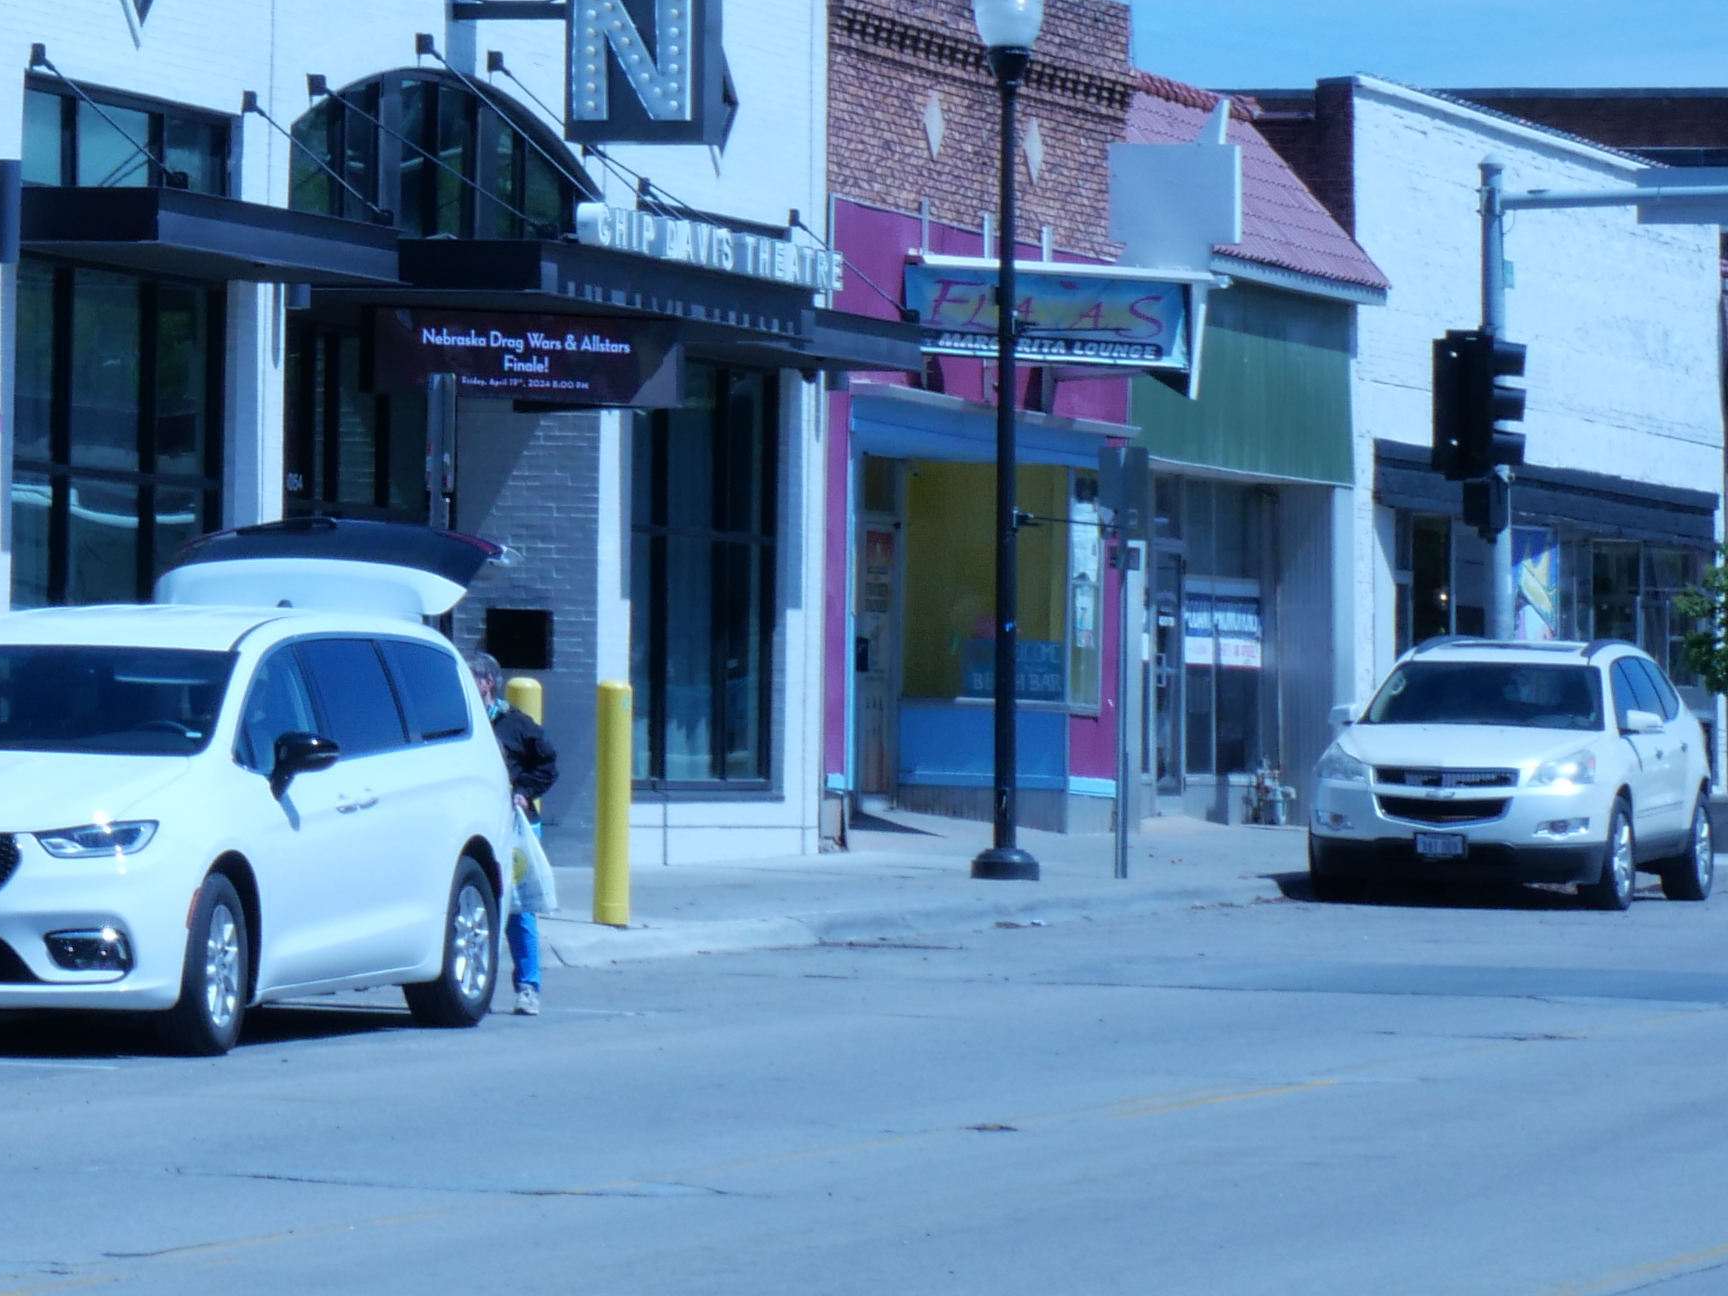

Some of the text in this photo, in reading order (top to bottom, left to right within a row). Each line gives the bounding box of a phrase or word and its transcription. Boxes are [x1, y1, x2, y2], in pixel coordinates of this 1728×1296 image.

[592, 203, 844, 292] CHIP DAVIS THEATRE
[421, 327, 631, 354] Nebraska Drag Wars & Allstars
[938, 332, 1158, 360] MARGRITA LOUNGE
[503, 354, 550, 373] Finale!
